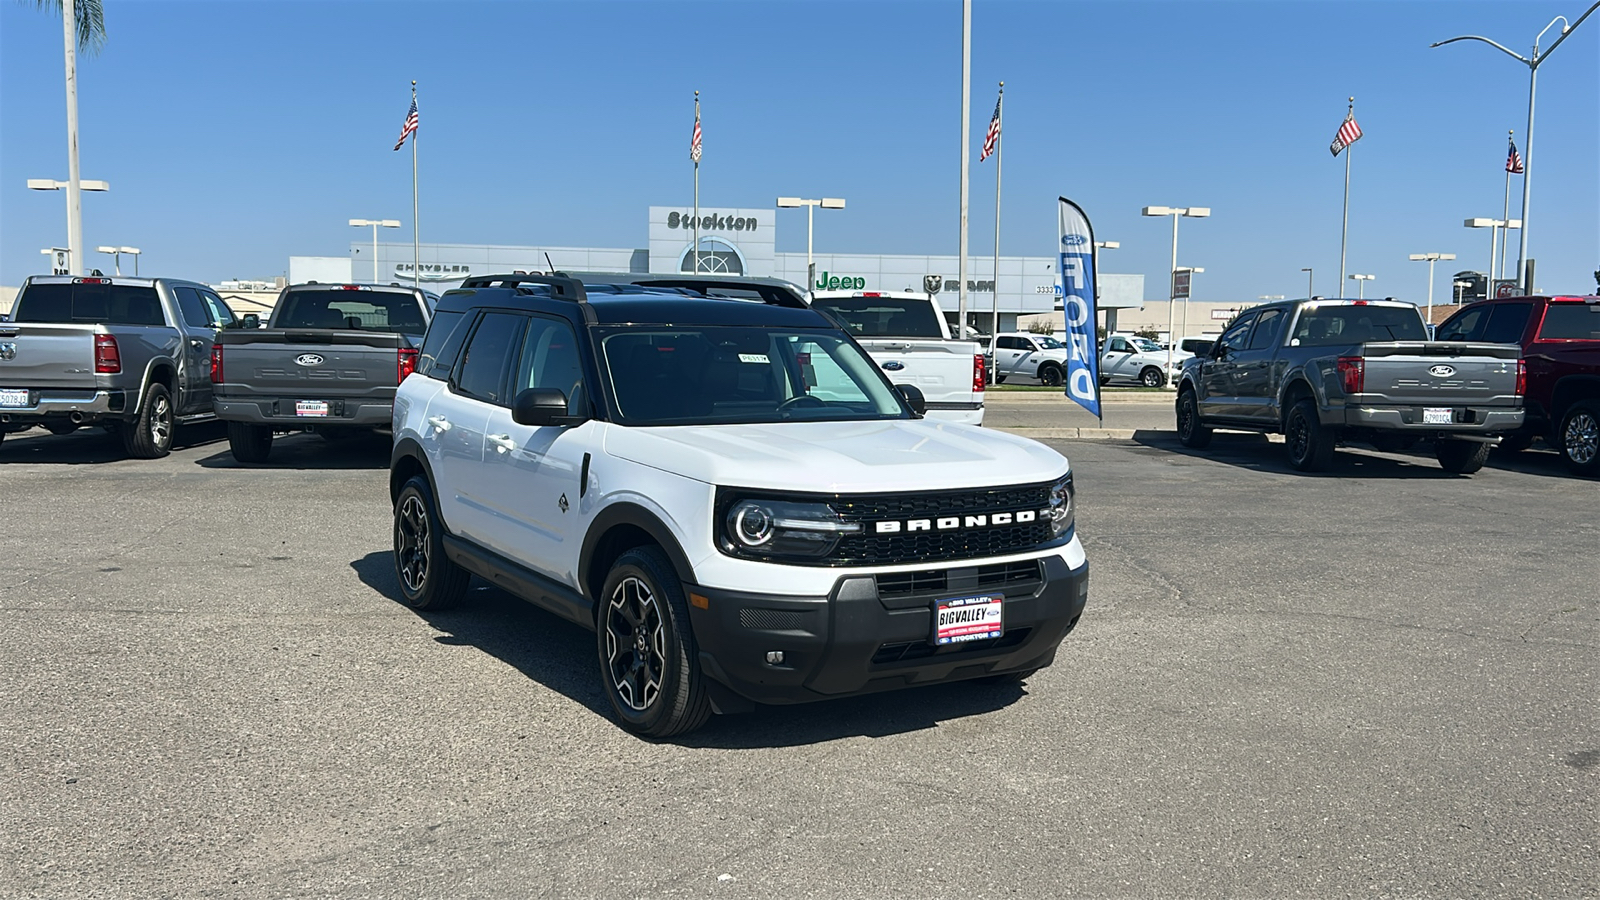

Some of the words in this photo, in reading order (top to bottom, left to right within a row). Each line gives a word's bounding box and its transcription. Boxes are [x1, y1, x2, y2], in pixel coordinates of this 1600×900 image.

[667, 211, 758, 231] Stockton
[396, 264, 470, 273] CHRYSLER
[816, 271, 865, 290] Jeep
[944, 280, 995, 292] RAM
[1036, 286, 1054, 294] 3333
[0, 395, 27, 404] 5078J3
[876, 510, 1036, 533] BRONCO
[940, 607, 987, 626] BIGVALLEY
[951, 632, 989, 643] STOCKTON
